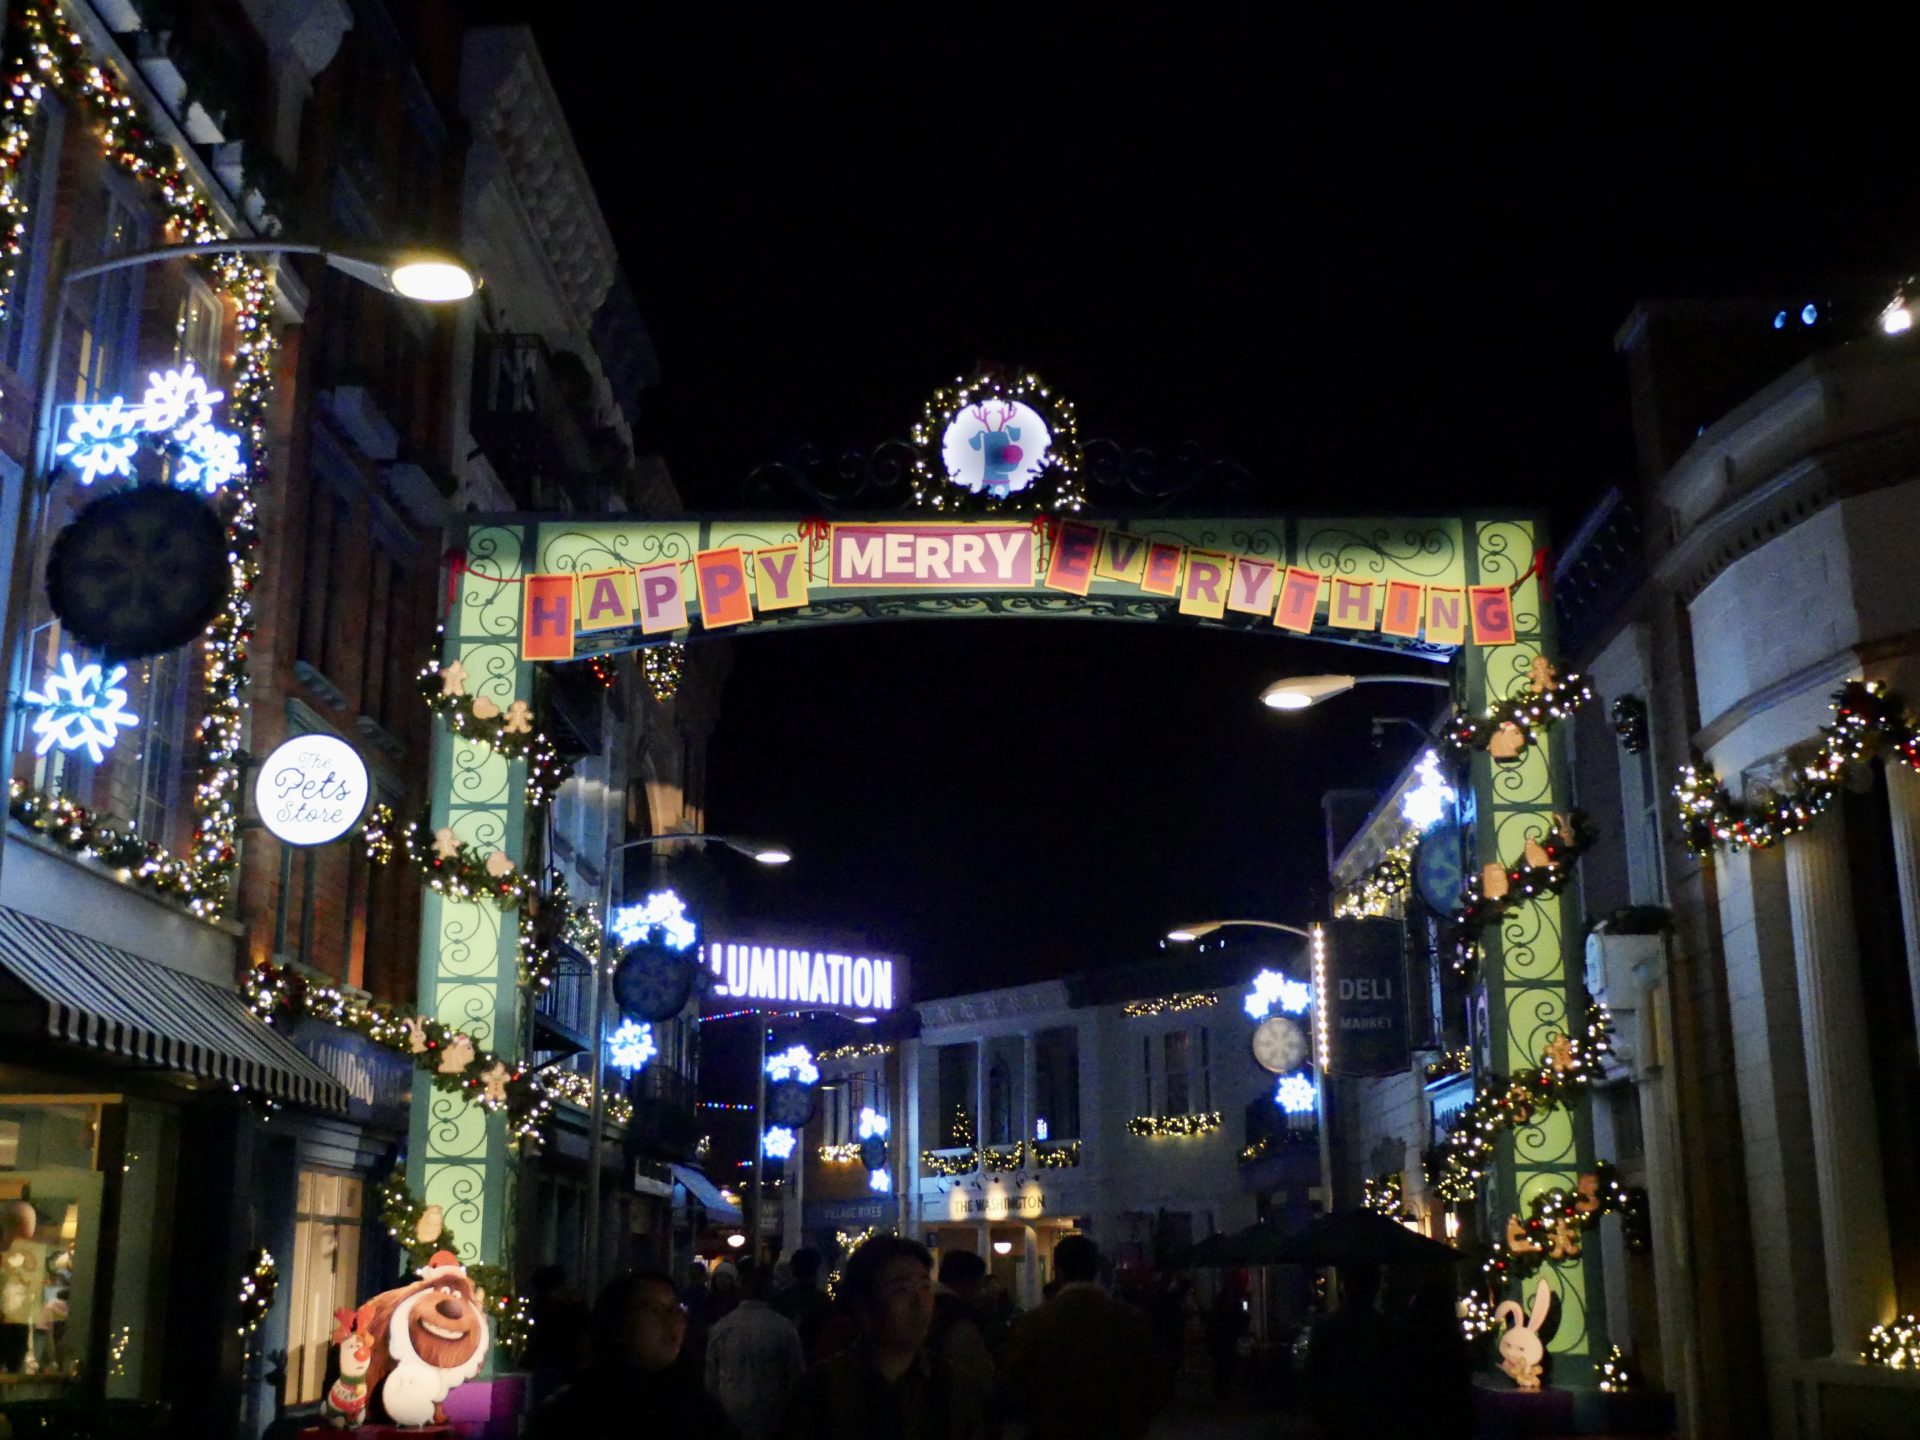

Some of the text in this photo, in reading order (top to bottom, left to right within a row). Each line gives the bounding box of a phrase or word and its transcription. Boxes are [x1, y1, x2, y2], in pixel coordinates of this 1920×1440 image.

[531, 531, 1508, 637] HAPPY MERRY EVERYTHING
[298, 752, 332, 769] The
[274, 767, 351, 801] Pets
[276, 801, 344, 823] Store
[698, 943, 892, 1010] LUMINATION
[1338, 978, 1392, 1000] DELI
[954, 1195, 1046, 1213] THE WASHINGTON
